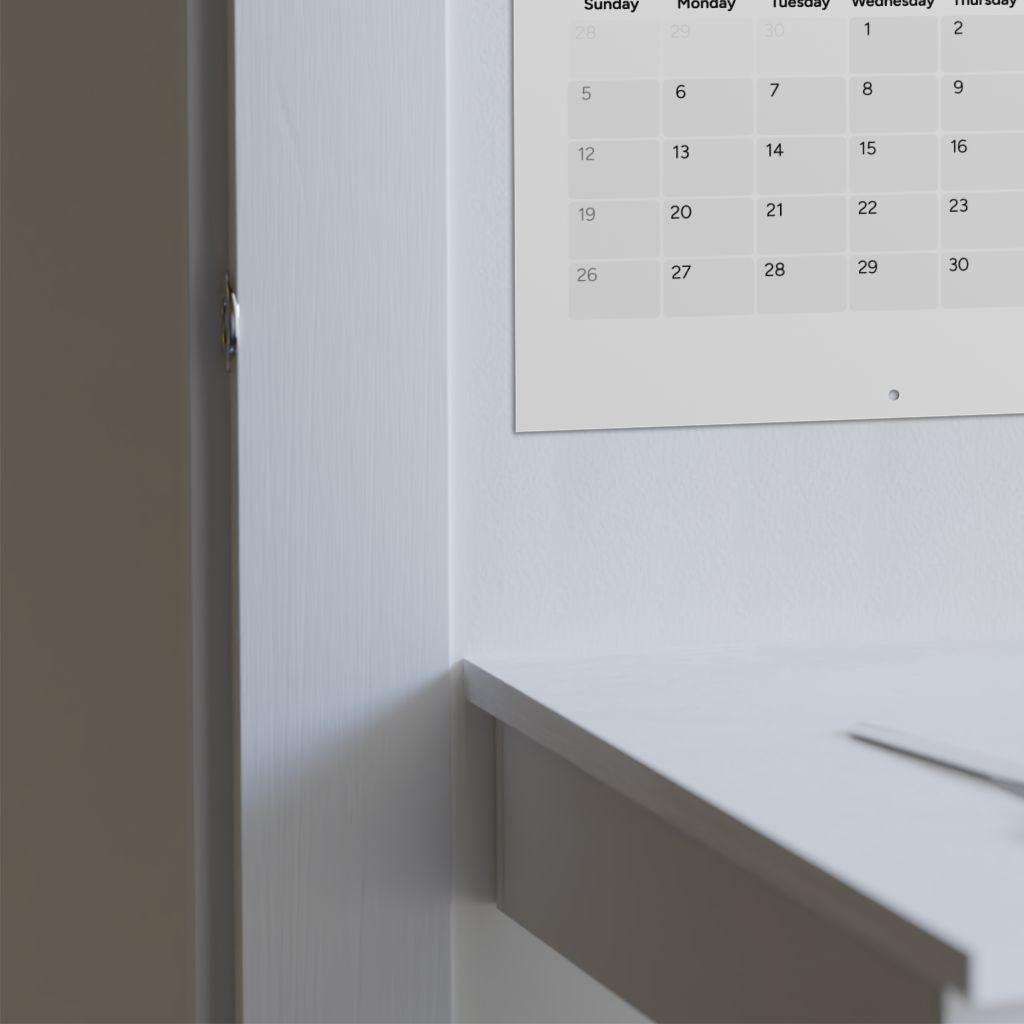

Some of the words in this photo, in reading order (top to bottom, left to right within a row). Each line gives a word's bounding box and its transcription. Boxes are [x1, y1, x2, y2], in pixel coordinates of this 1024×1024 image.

[575, 25, 597, 40] 28
[670, 23, 691, 39] 29
[764, 22, 785, 38] 30
[953, 20, 964, 36] 2
[581, 85, 592, 101] 5
[675, 84, 687, 99] 6
[769, 82, 780, 98] 7
[862, 81, 873, 96] 8
[953, 79, 964, 95] 9
[578, 146, 595, 161] 12
[672, 144, 690, 160] 13
[766, 142, 785, 158] 14
[859, 140, 877, 156] 15
[950, 138, 968, 154] 16
[578, 206, 596, 222] 19
[670, 204, 692, 220] 20
[766, 202, 783, 218] 21
[857, 200, 878, 215] 22
[949, 198, 969, 213] 23
[576, 267, 598, 282] 26
[671, 264, 692, 280] 27
[764, 261, 786, 277] 28
[857, 259, 878, 275] 29
[948, 256, 970, 272] 30
